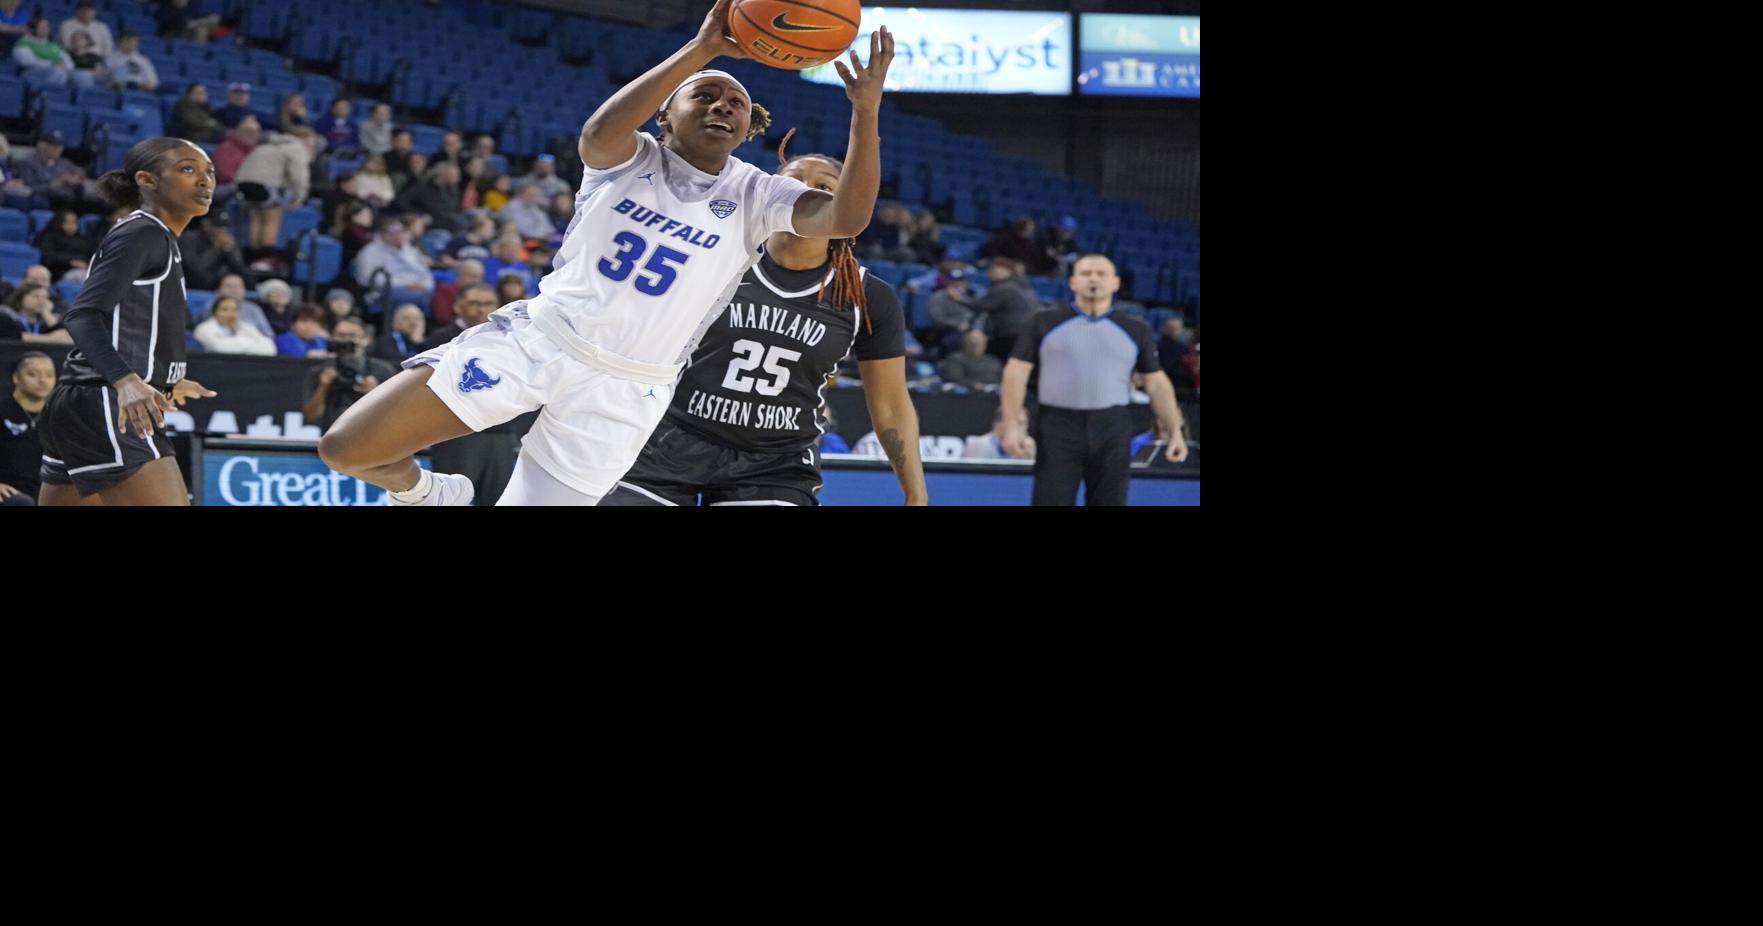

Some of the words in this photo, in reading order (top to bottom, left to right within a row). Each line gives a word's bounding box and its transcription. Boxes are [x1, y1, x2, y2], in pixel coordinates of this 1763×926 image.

[611, 198, 721, 250] BUFFALO
[597, 230, 691, 297] 35
[729, 302, 827, 348] MARYLAND
[721, 338, 802, 397] 25
[687, 390, 752, 428] EASTERN
[754, 403, 801, 431] SHORE
[218, 456, 350, 506] Great
